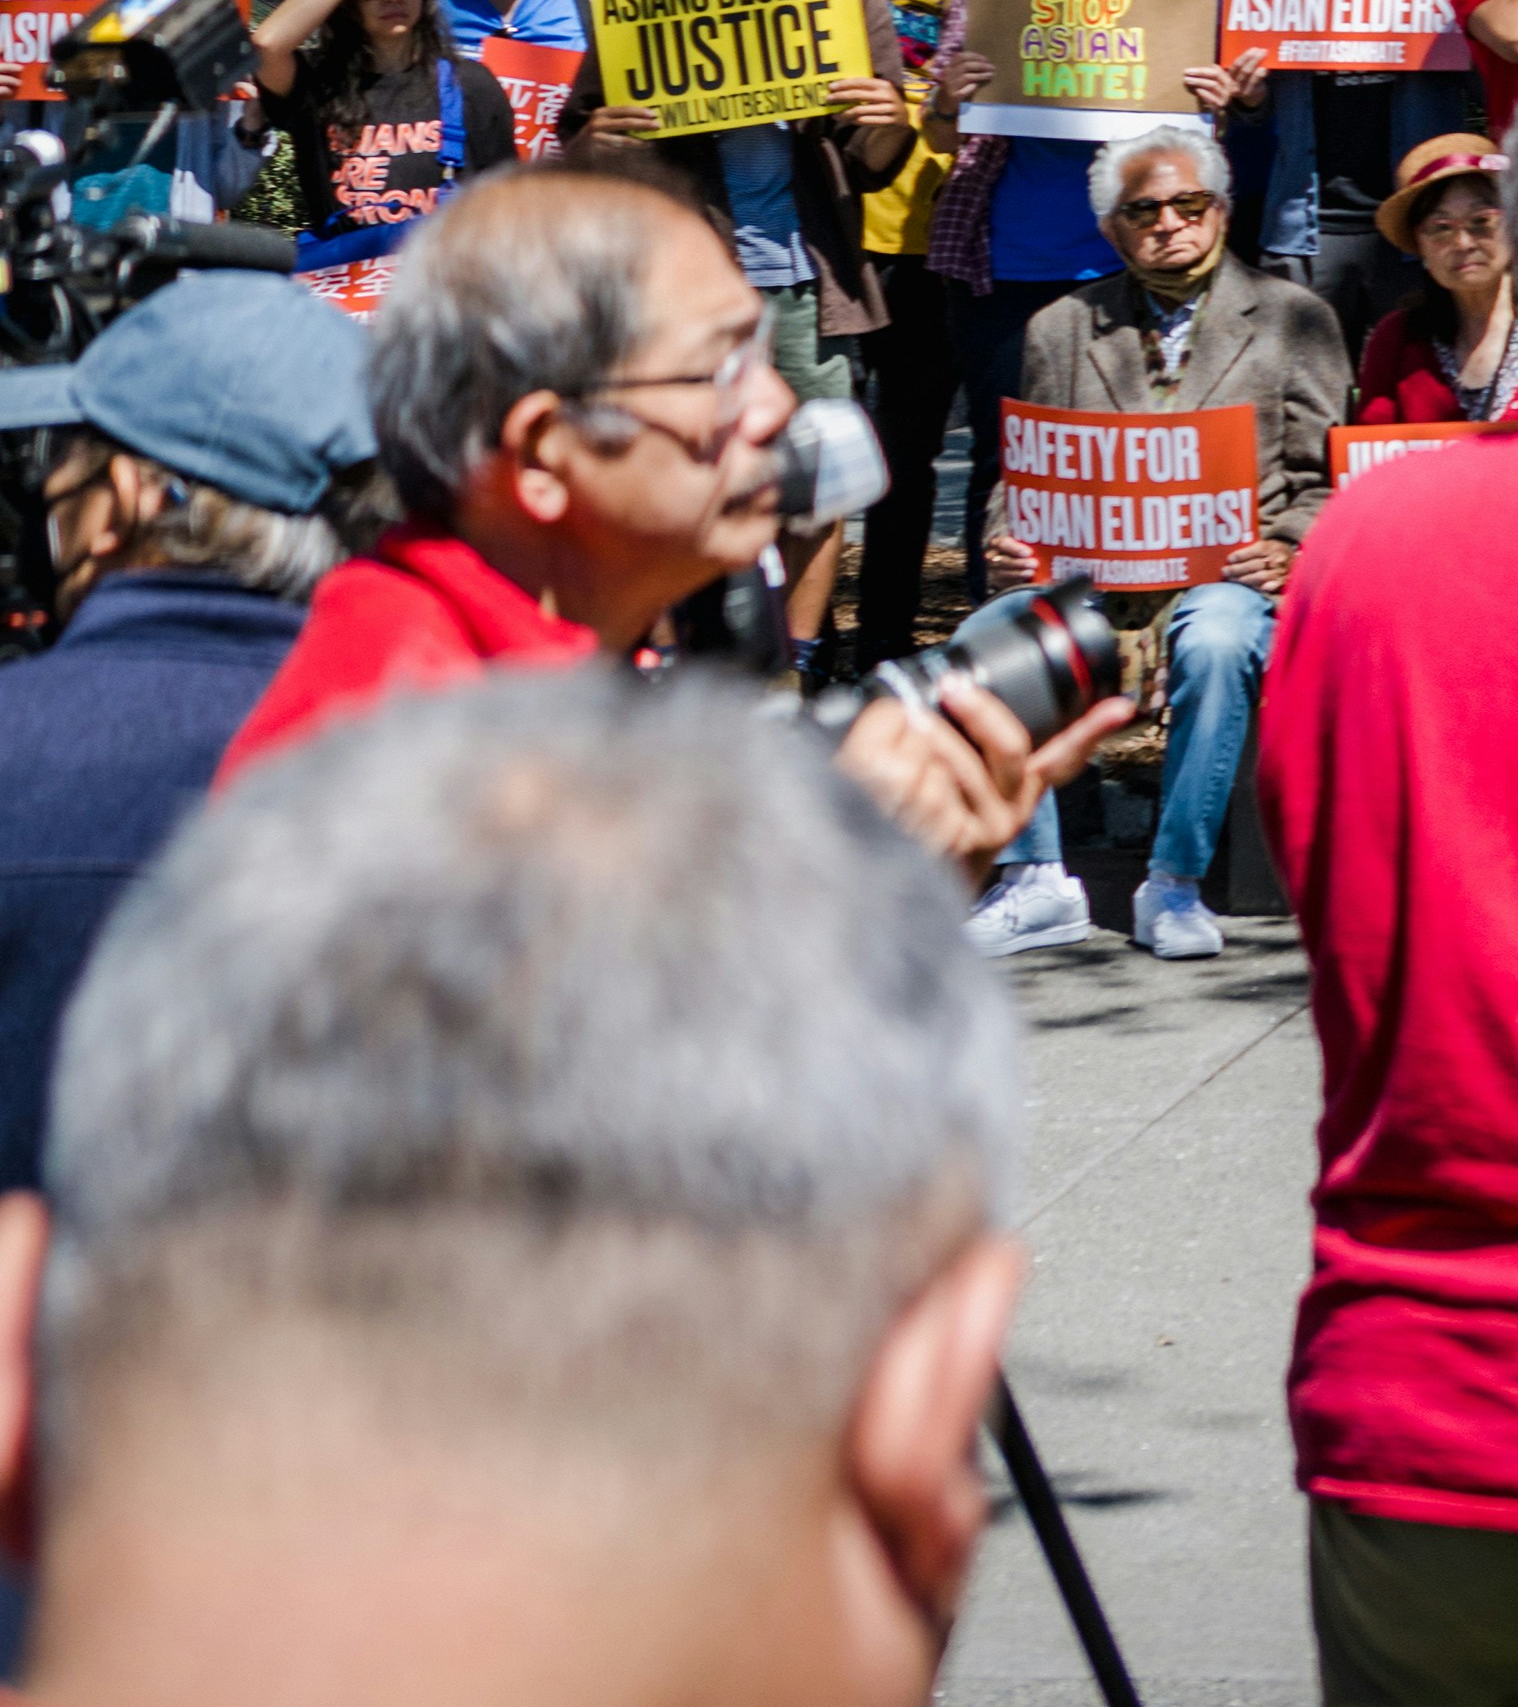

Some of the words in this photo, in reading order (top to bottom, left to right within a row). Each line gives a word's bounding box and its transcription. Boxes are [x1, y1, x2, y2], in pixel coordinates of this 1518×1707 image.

[626, 0, 840, 101] JUSTICE
[1021, 25, 1144, 63] ASIAN
[1022, 61, 1147, 100] HATE!
[1004, 414, 1118, 483] SAFETY
[1123, 426, 1201, 484] FOR
[1006, 485, 1096, 550] ASIAN
[1100, 488, 1255, 552] ELDERS!
